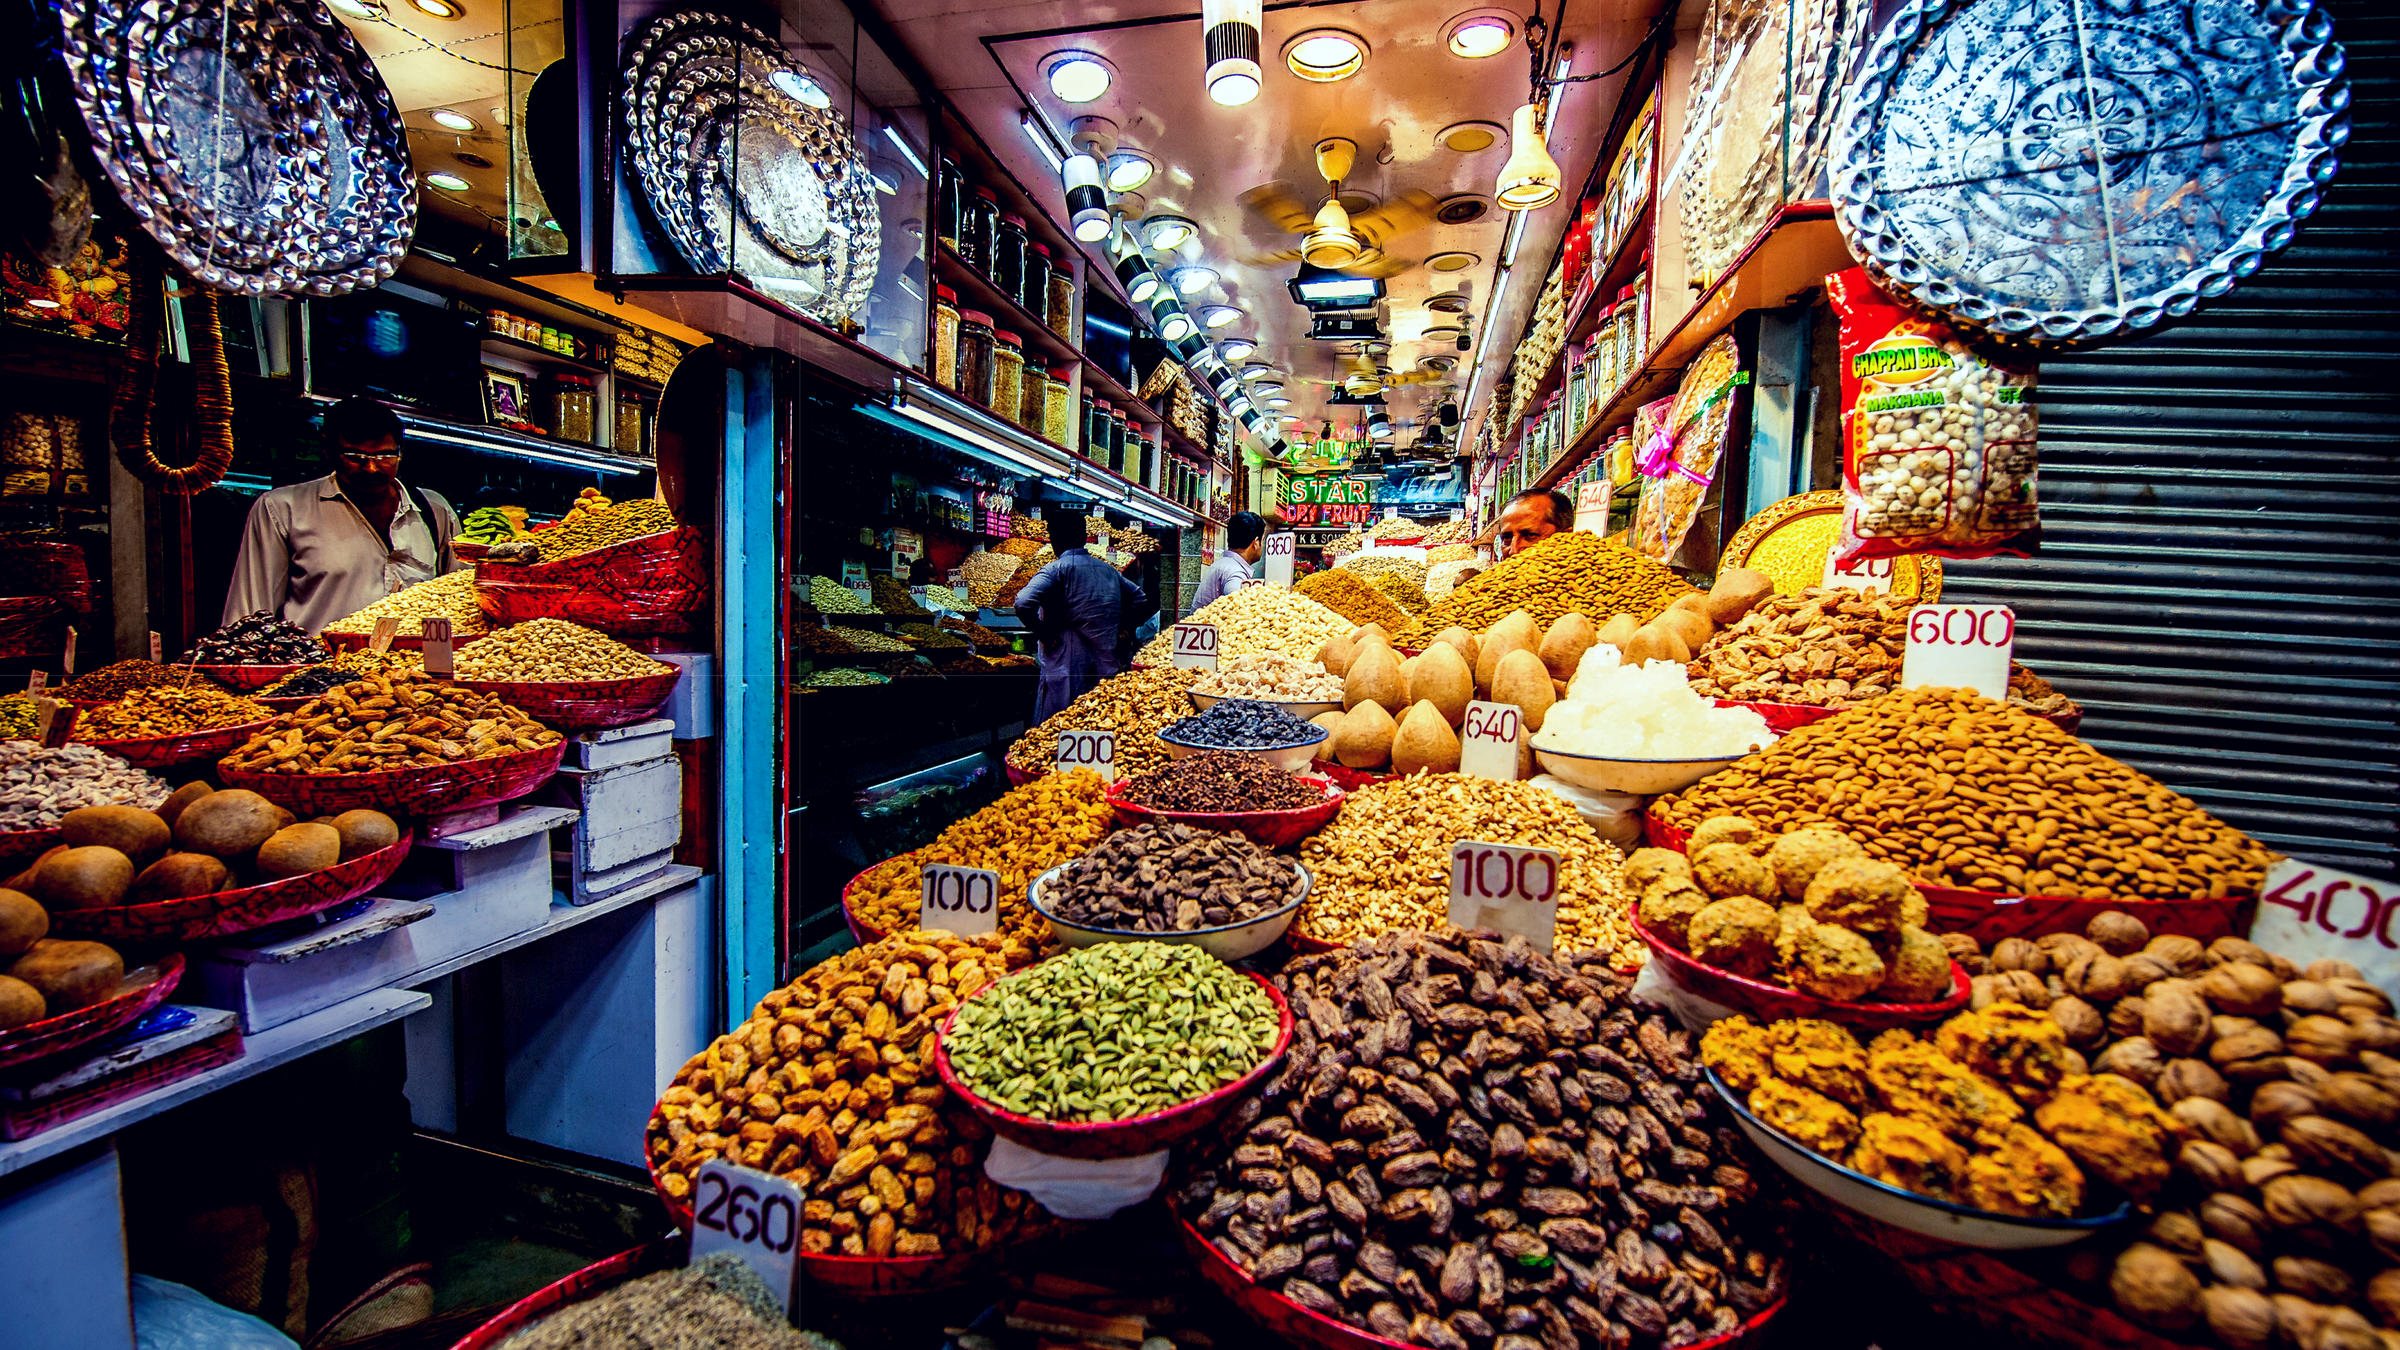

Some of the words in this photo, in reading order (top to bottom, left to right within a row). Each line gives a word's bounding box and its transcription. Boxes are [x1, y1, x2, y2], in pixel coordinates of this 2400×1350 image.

[1853, 347, 1916, 378] CHAPPAN
[1867, 391, 1944, 412] MAKHANA
[1291, 480, 1367, 502] STAR
[1579, 484, 1608, 508] 640
[1287, 504, 1317, 522] DRY
[1321, 504, 1370, 522] FRUIT
[1267, 536, 1291, 555] 860
[1310, 534, 1317, 543] &
[422, 620, 448, 642] 200
[1175, 627, 1215, 651] 720
[1911, 609, 2014, 647] 600
[1466, 707, 1518, 743] 640
[1060, 735, 1114, 764] 200
[1456, 850, 1556, 902] 100
[925, 870, 993, 913] 100
[697, 1171, 796, 1254] 260
